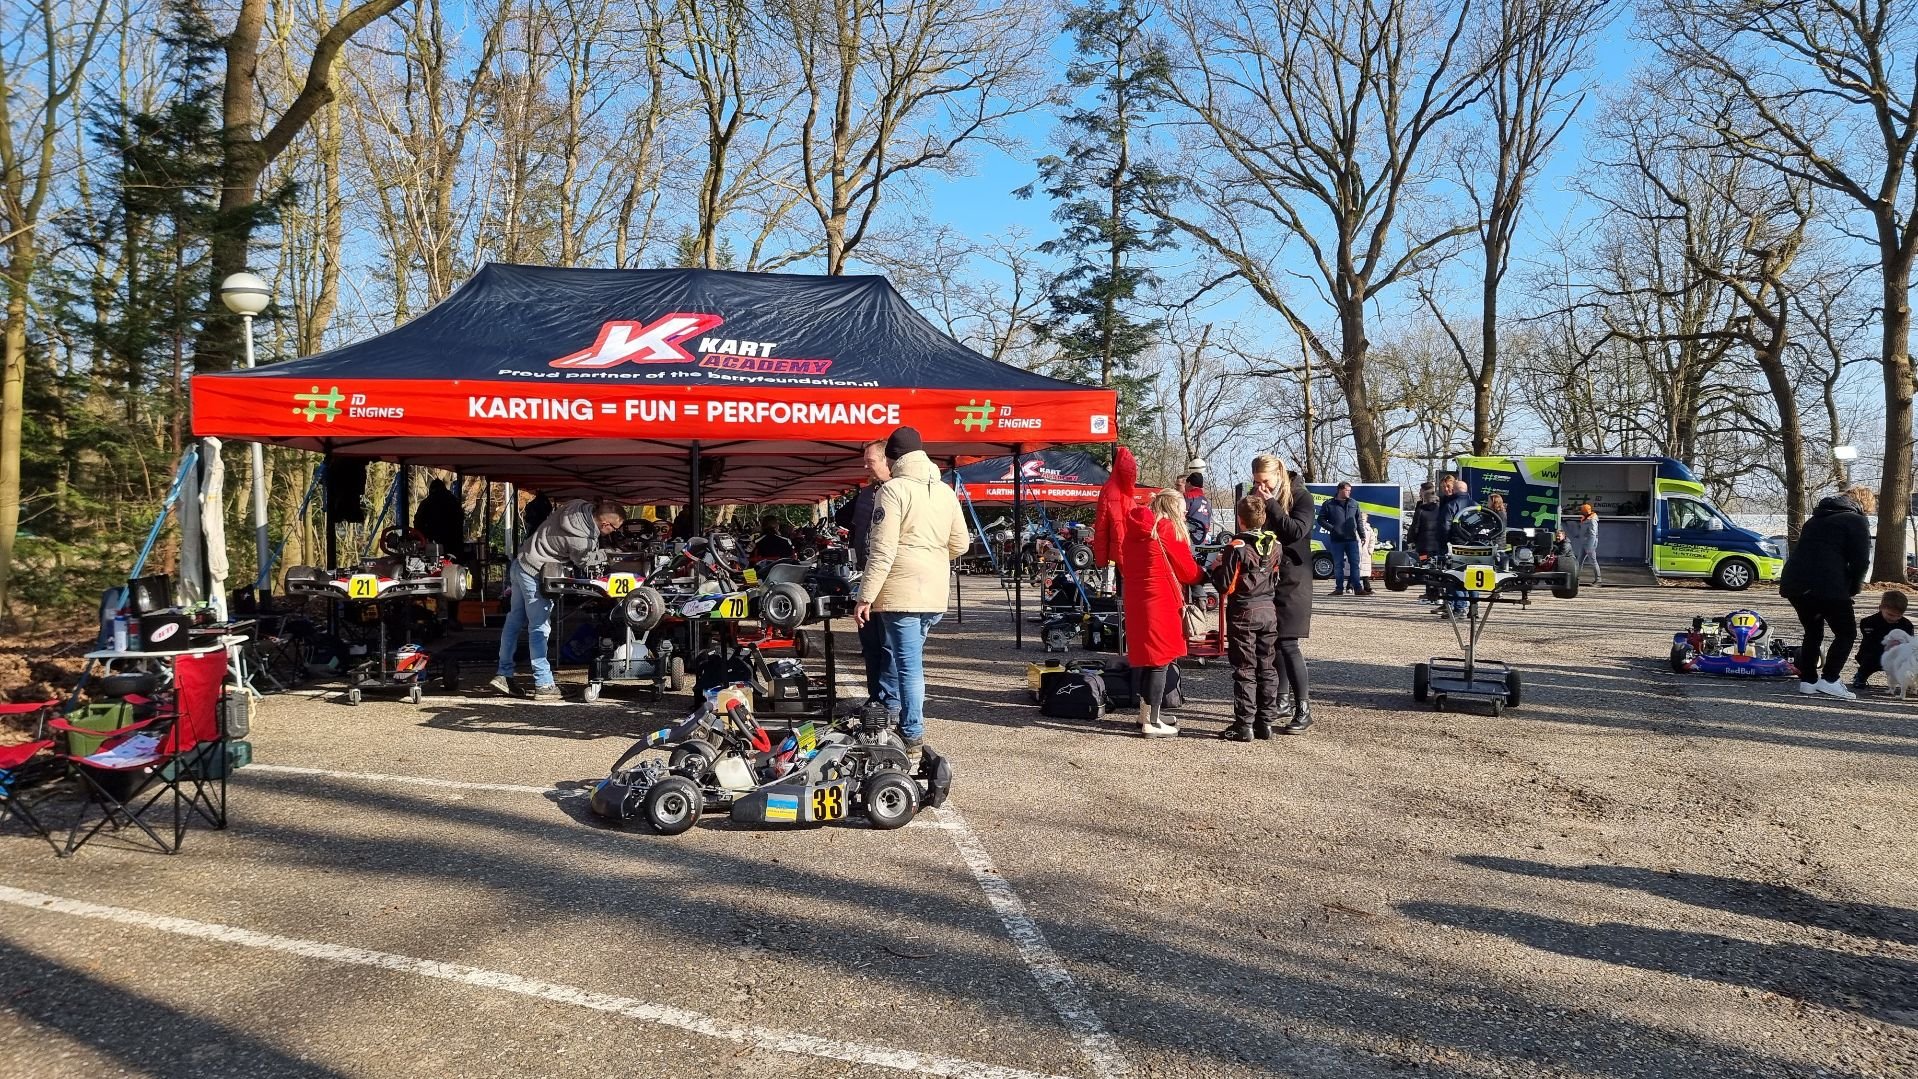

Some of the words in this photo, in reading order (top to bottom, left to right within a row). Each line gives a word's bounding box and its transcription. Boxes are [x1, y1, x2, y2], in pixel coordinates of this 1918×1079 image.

[698, 338, 777, 358] KART
[703, 355, 830, 374] ACADEMY
[498, 369, 560, 378] Proud
[645, 371, 666, 379] of
[708, 371, 879, 387] barryfoundation.nl
[468, 396, 594, 421] KARTING
[625, 399, 676, 421] FUN
[707, 401, 900, 425] PERFORMANCE
[986, 488, 1015, 496] KARTIN
[356, 579, 370, 596] 21
[615, 578, 630, 595] 28
[1475, 570, 1485, 588] 9
[728, 598, 744, 618] 70
[1738, 616, 1749, 625] 17
[813, 785, 843, 821] 33
